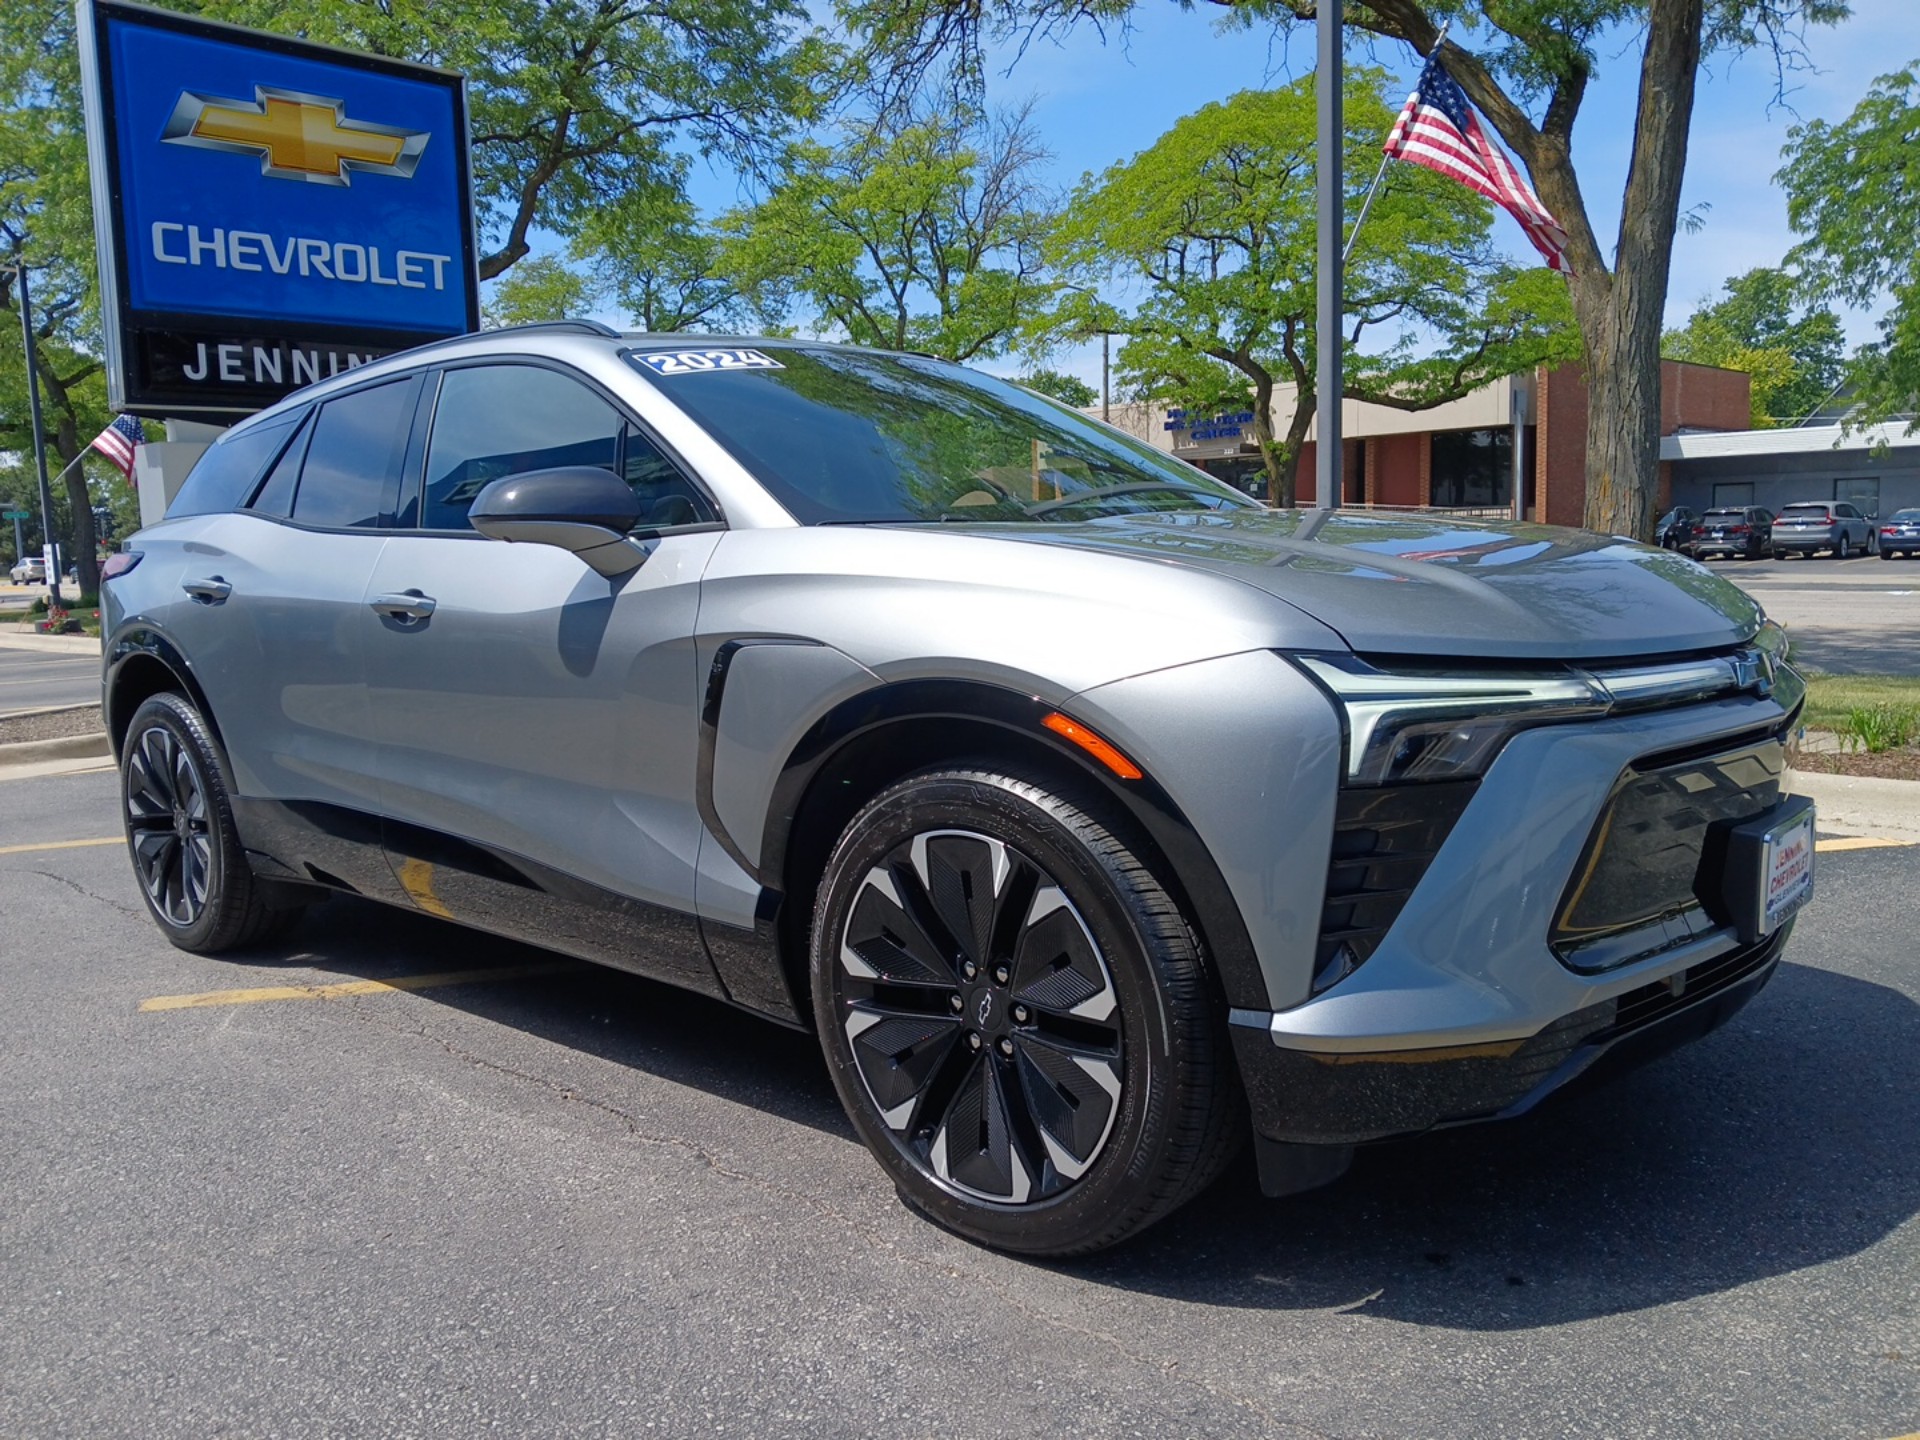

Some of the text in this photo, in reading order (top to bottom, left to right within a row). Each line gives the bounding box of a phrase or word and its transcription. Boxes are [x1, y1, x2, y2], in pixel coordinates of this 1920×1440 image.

[151, 221, 451, 290] CHEVROLET
[648, 351, 770, 372] 2024
[1770, 852, 1809, 894] CHEVROLET
